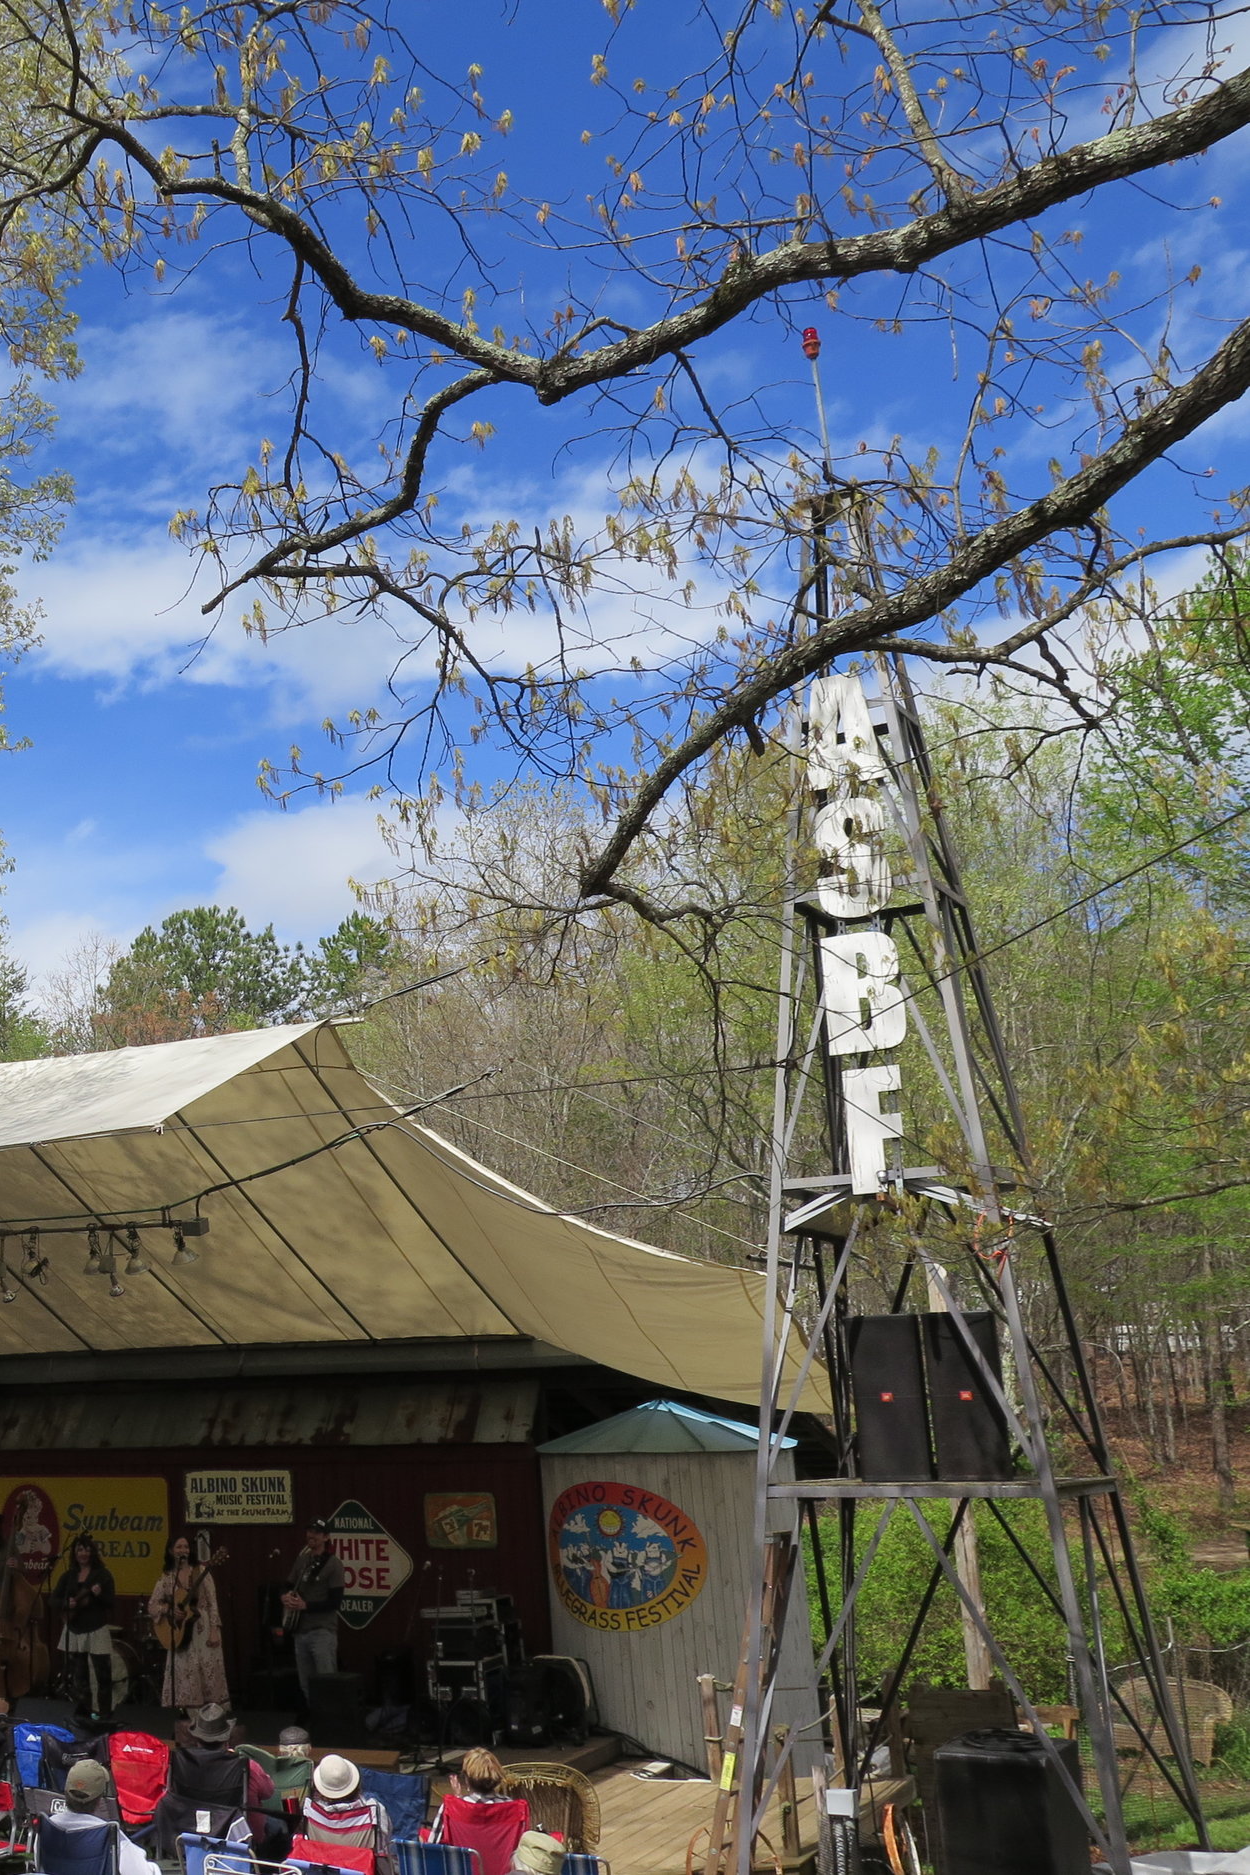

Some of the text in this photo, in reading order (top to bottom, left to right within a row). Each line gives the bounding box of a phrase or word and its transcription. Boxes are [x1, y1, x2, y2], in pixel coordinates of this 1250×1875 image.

[190, 1477, 286, 1493] ALBINO SKUNK
[215, 1495, 287, 1505] MUSIC FESTIVAL
[63, 1503, 163, 1532] Sunbeam
[334, 1517, 374, 1529] NATIONAL
[552, 1484, 697, 1553] ALBINO SKUNK
[93, 1540, 151, 1558] READ
[343, 1566, 391, 1590] OSE
[340, 1599, 374, 1612] DEALER
[624, 1563, 701, 1631] FESTIVAL
